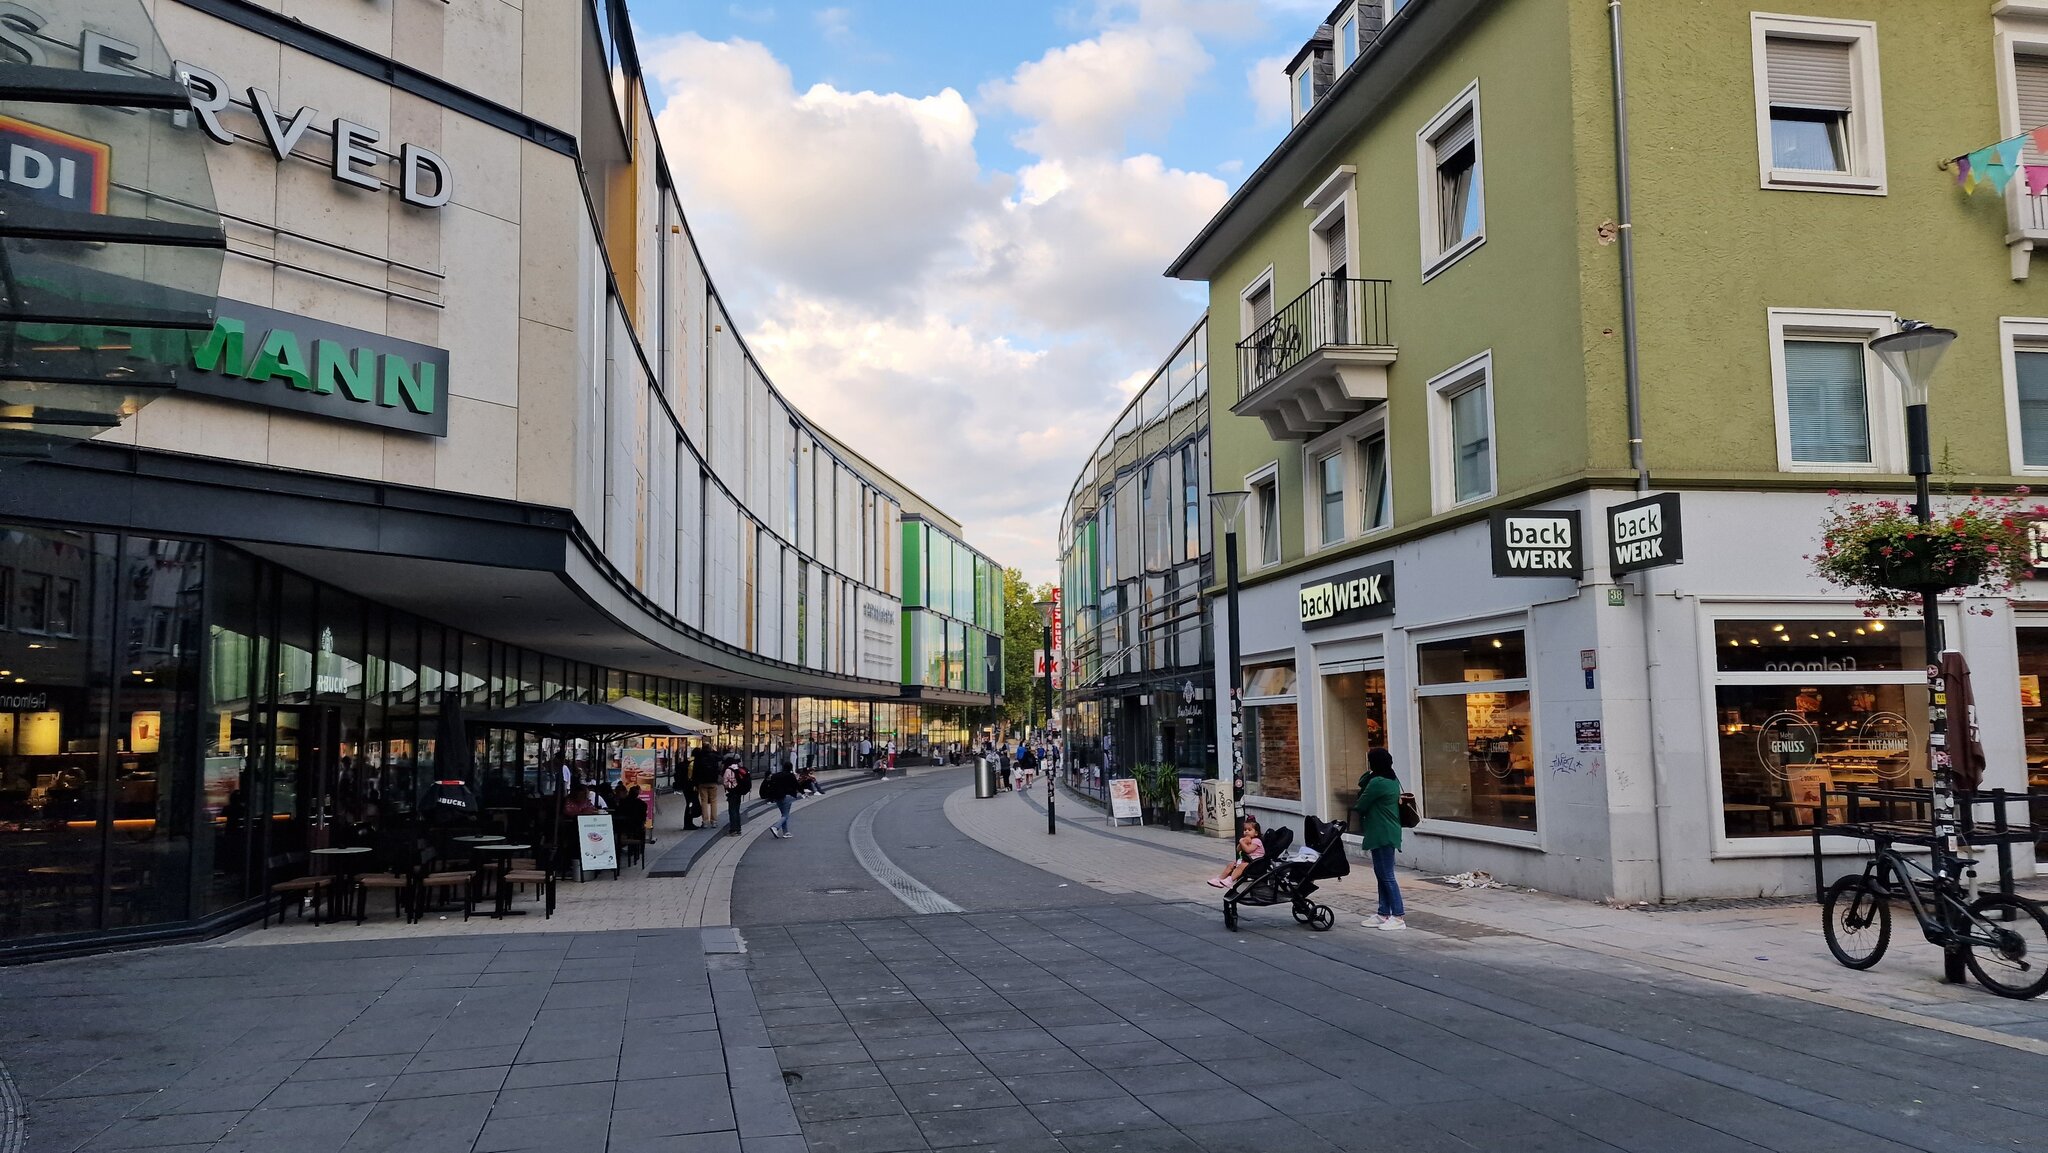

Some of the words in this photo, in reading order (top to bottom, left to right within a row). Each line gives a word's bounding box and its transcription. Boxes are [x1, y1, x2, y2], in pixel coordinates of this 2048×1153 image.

[0, 144, 76, 199] DI
[1510, 522, 1567, 544] back
[1617, 509, 1659, 540] back
[1507, 550, 1572, 569] WERK
[1615, 537, 1663, 565] WERK
[1610, 590, 1623, 600] 38
[1038, 656, 1058, 673] kk
[1771, 741, 1805, 753] GENUSS
[1868, 738, 1909, 751] VITAMINE
